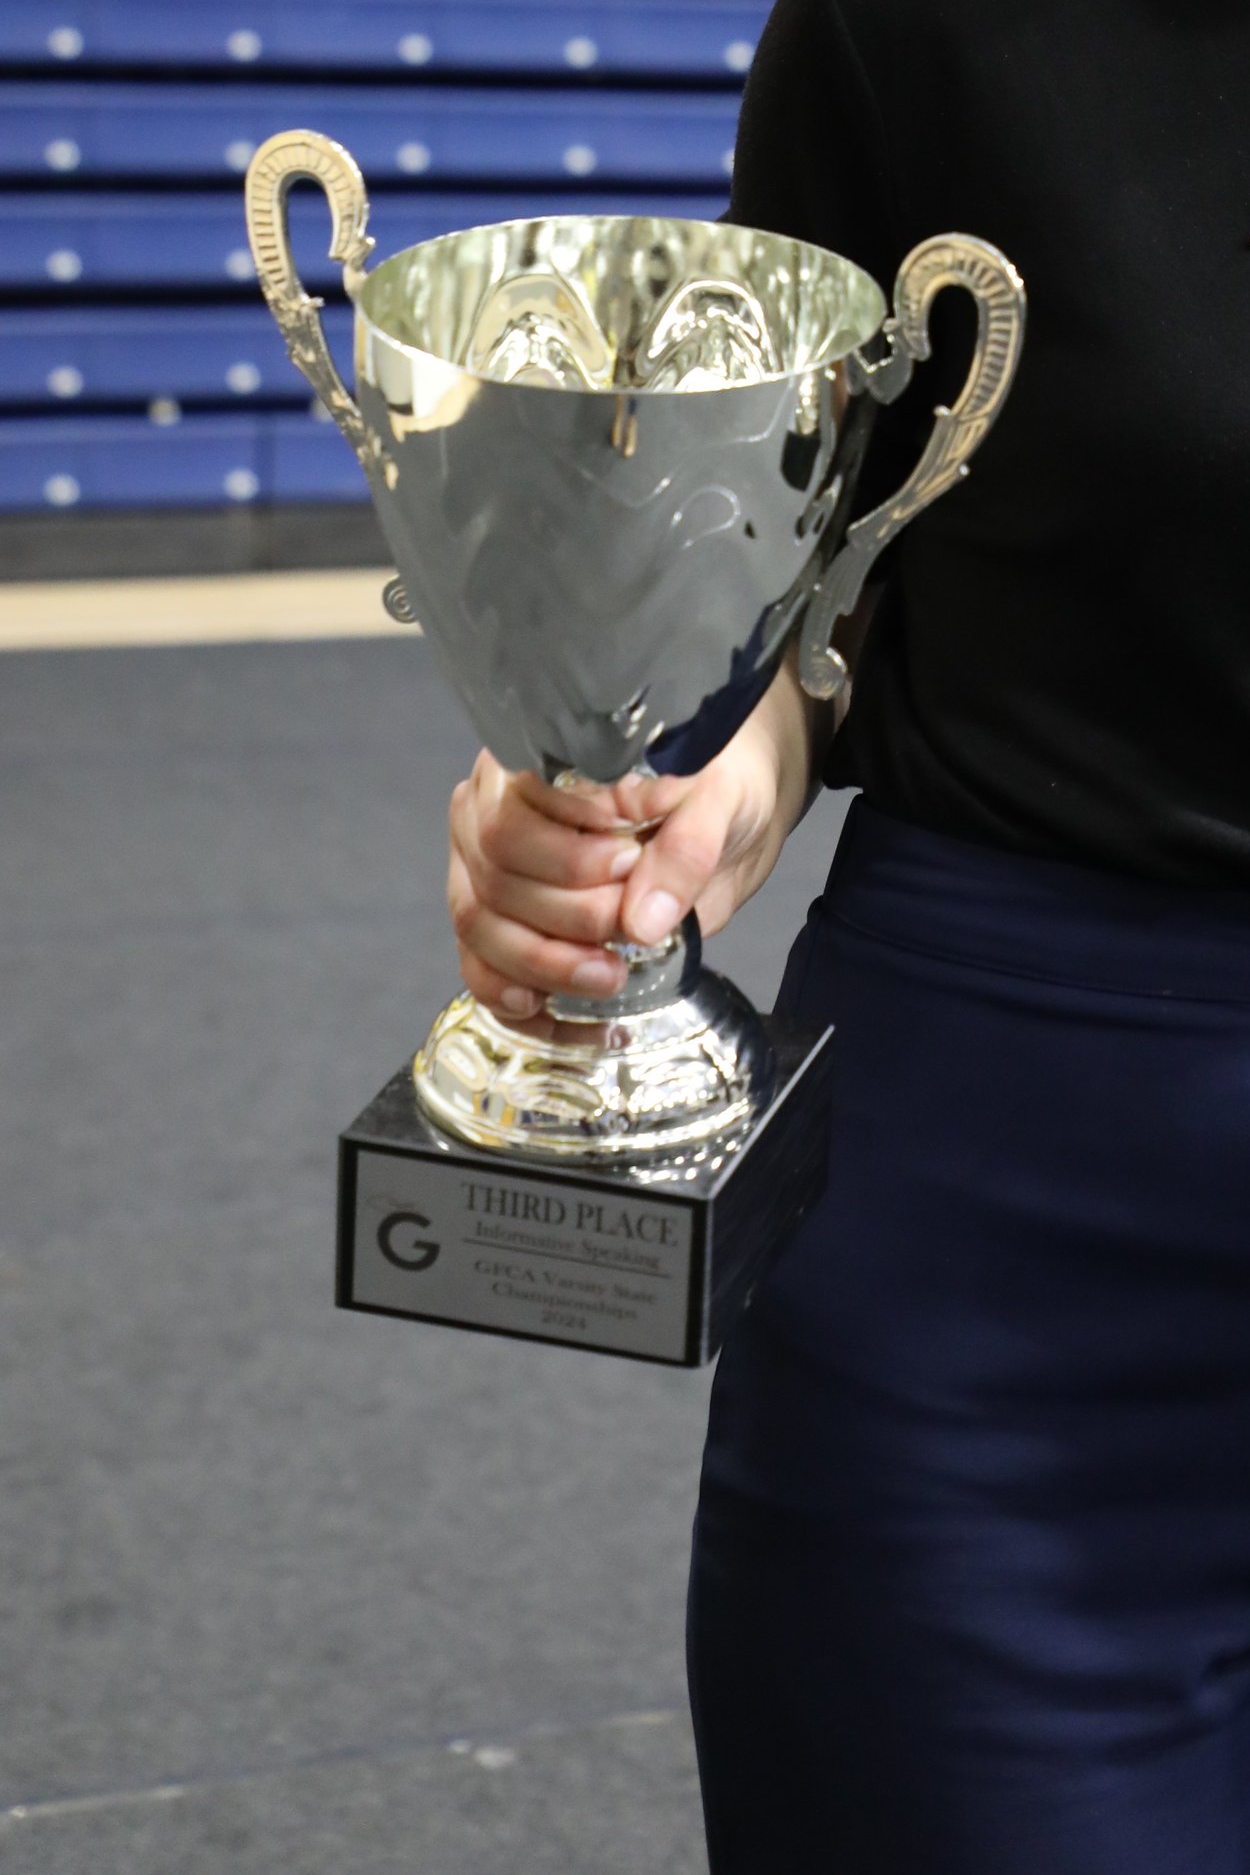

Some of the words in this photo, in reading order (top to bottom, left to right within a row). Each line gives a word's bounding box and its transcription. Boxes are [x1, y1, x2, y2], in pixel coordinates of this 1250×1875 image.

[460, 1180, 567, 1226] THIRD
[575, 1200, 679, 1248] PLACE
[376, 1209, 441, 1273] G
[476, 1220, 575, 1253] Informative
[581, 1237, 661, 1272] Speaking
[490, 1280, 639, 1321] Championships
[542, 1270, 607, 1297] Varsity
[612, 1282, 658, 1304] State
